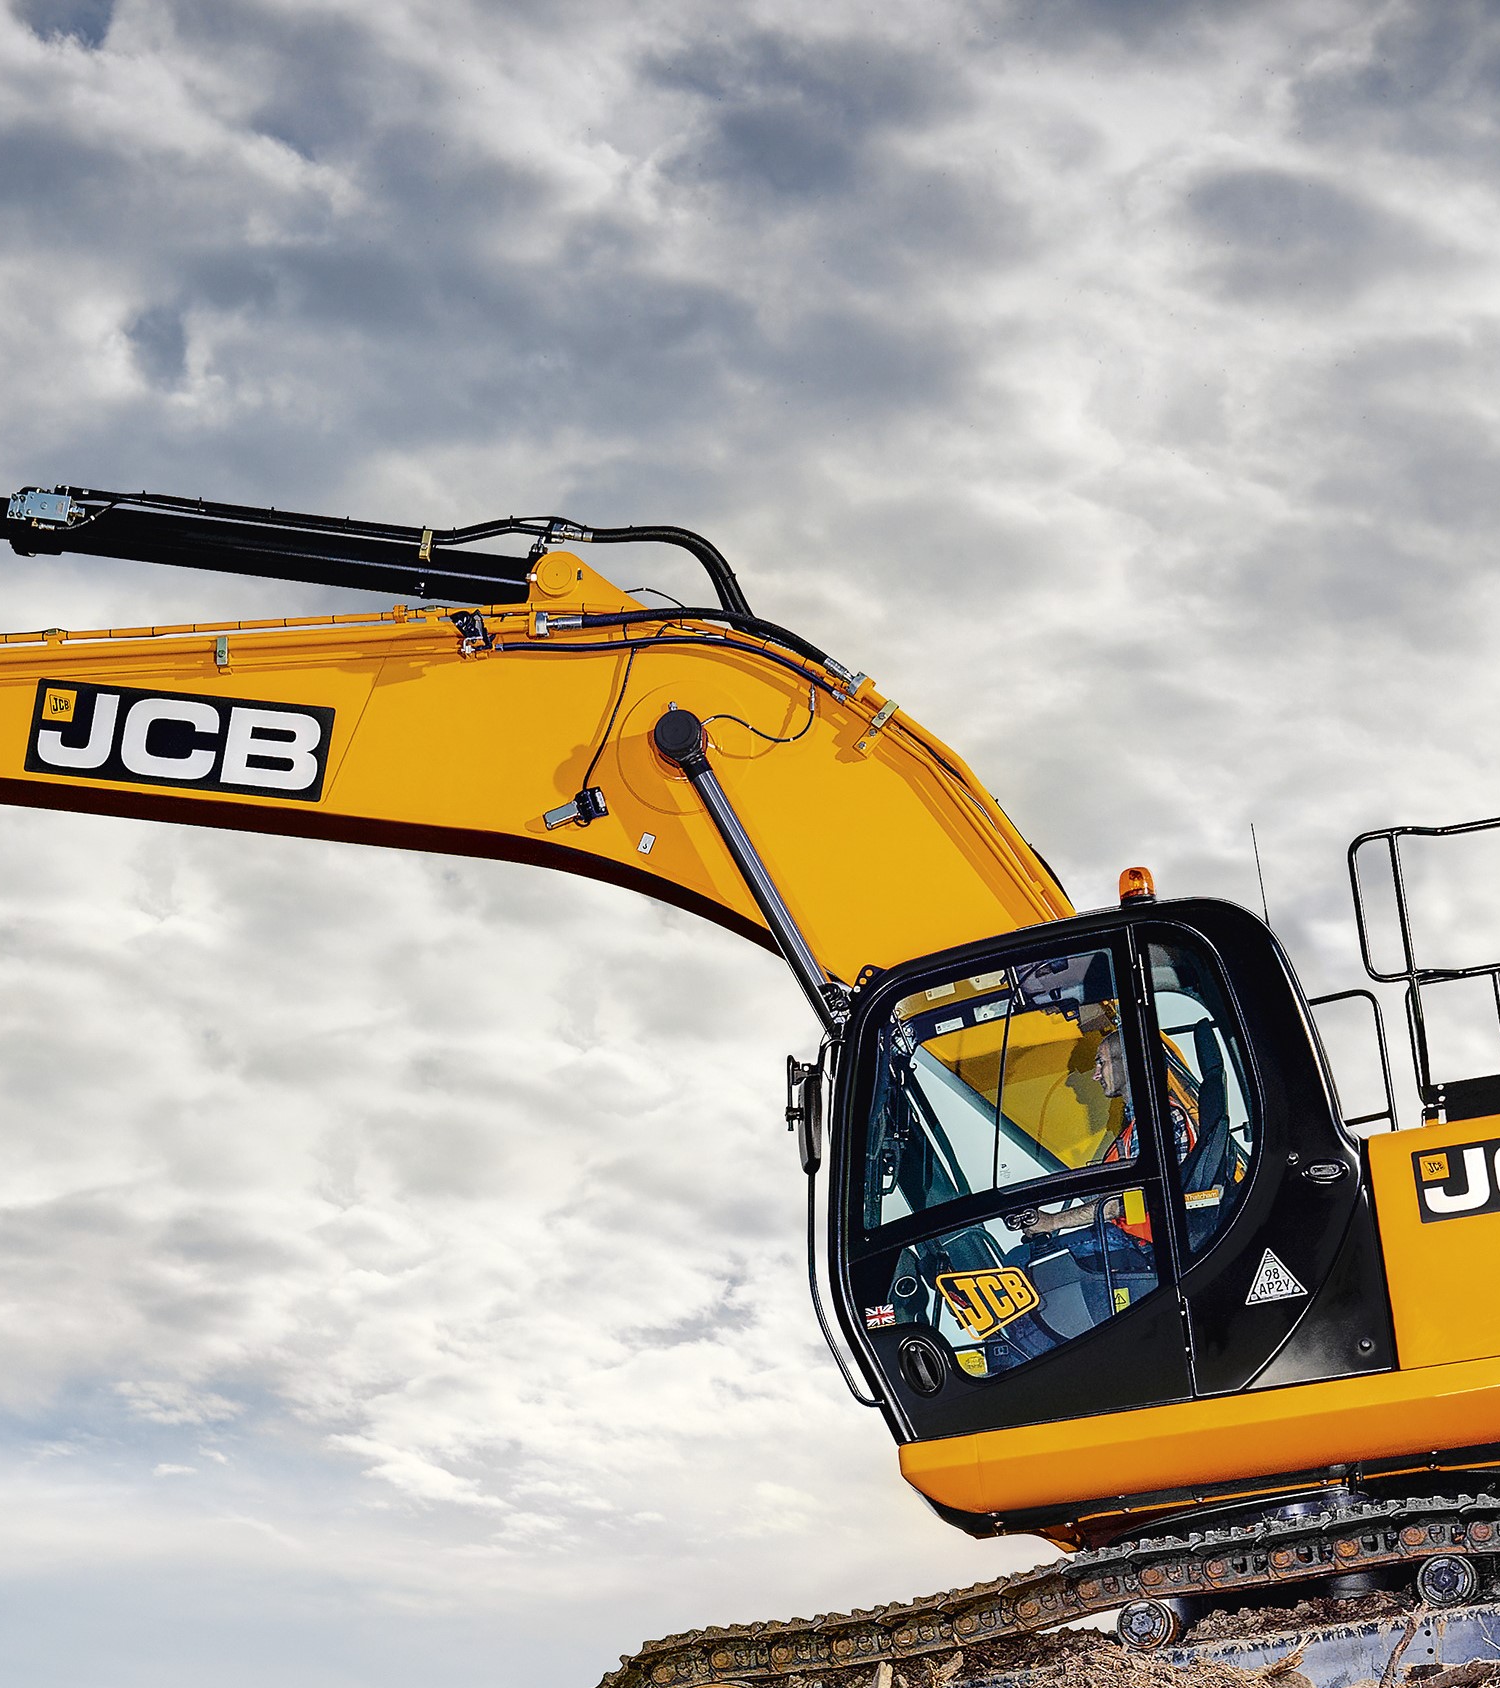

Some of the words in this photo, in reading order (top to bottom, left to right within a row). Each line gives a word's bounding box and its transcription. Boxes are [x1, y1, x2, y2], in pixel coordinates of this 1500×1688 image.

[50, 695, 71, 714] JCB
[37, 693, 321, 790] JCB
[1427, 1160, 1444, 1174] JCB
[1265, 1268, 1280, 1281] 98
[1260, 1279, 1289, 1295] AP2Y
[953, 1273, 1032, 1332] JCB
